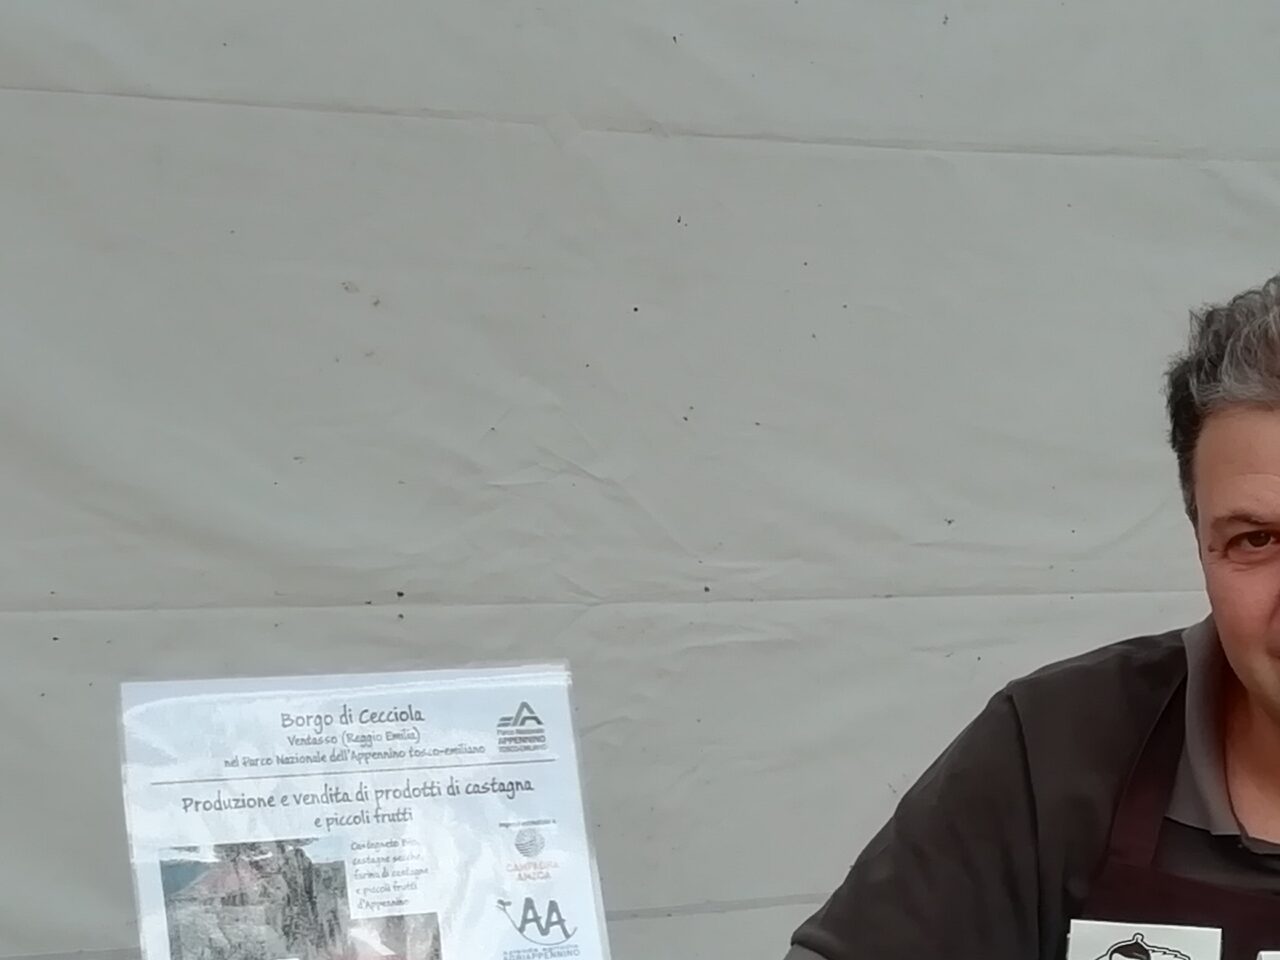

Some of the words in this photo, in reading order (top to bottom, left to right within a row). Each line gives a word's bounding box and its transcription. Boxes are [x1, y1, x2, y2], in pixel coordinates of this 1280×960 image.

[281, 713, 334, 734] Borgo
[339, 704, 354, 725] di
[359, 704, 425, 724] Cecciola
[287, 734, 337, 747] Ventasso
[342, 731, 383, 748] (Reggio
[385, 726, 420, 744] Emilia)
[224, 756, 239, 768] nel
[243, 756, 273, 767] Parco
[276, 751, 327, 766] Nazionale
[329, 747, 405, 766] dell'Appennino
[408, 744, 486, 758] tosco-emiliano
[182, 790, 275, 813] Produzione
[281, 795, 290, 806] e
[294, 783, 350, 806] vendita
[355, 782, 369, 802] di
[375, 778, 442, 809] prodotti
[447, 776, 460, 797] di
[465, 777, 535, 800] castagna
[314, 818, 323, 828] e
[326, 811, 370, 832] piccoli
[373, 807, 413, 824] frutti
